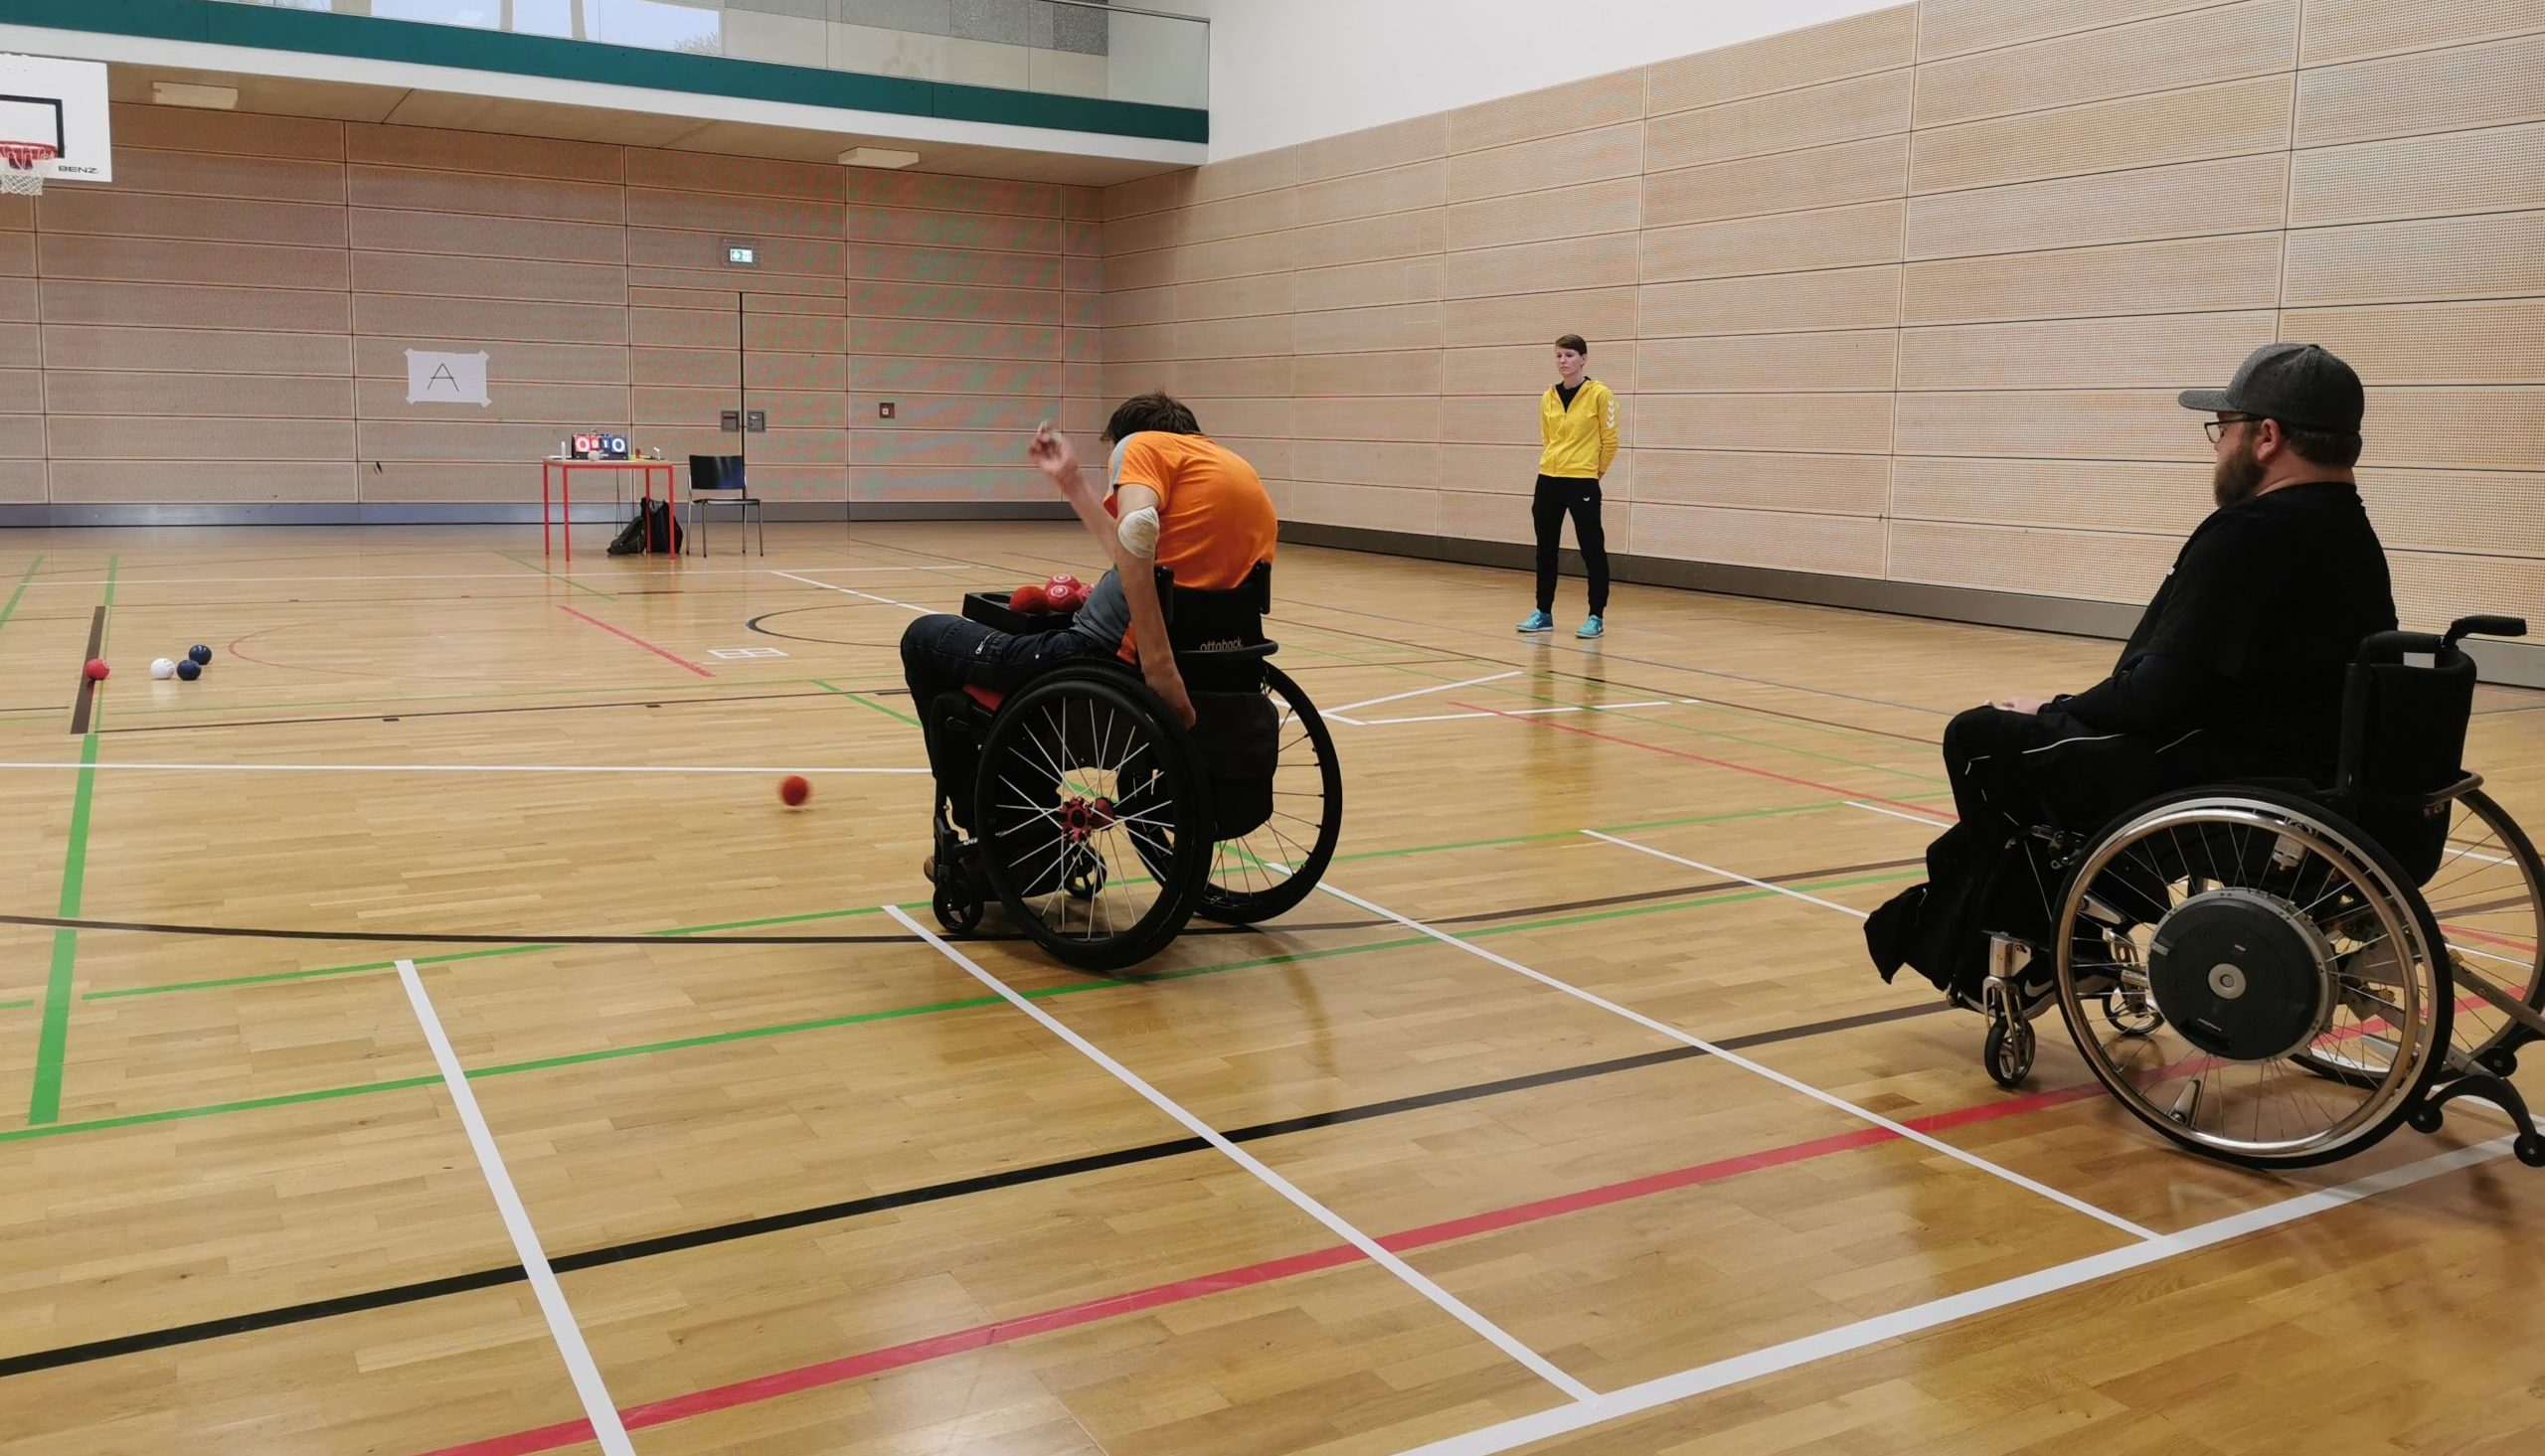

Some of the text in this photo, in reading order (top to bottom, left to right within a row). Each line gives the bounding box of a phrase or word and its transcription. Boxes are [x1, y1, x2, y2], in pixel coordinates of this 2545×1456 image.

[58, 165, 97, 174] BENZ
[426, 362, 460, 393] A
[575, 437, 590, 453] 0
[611, 437, 625, 453] 0
